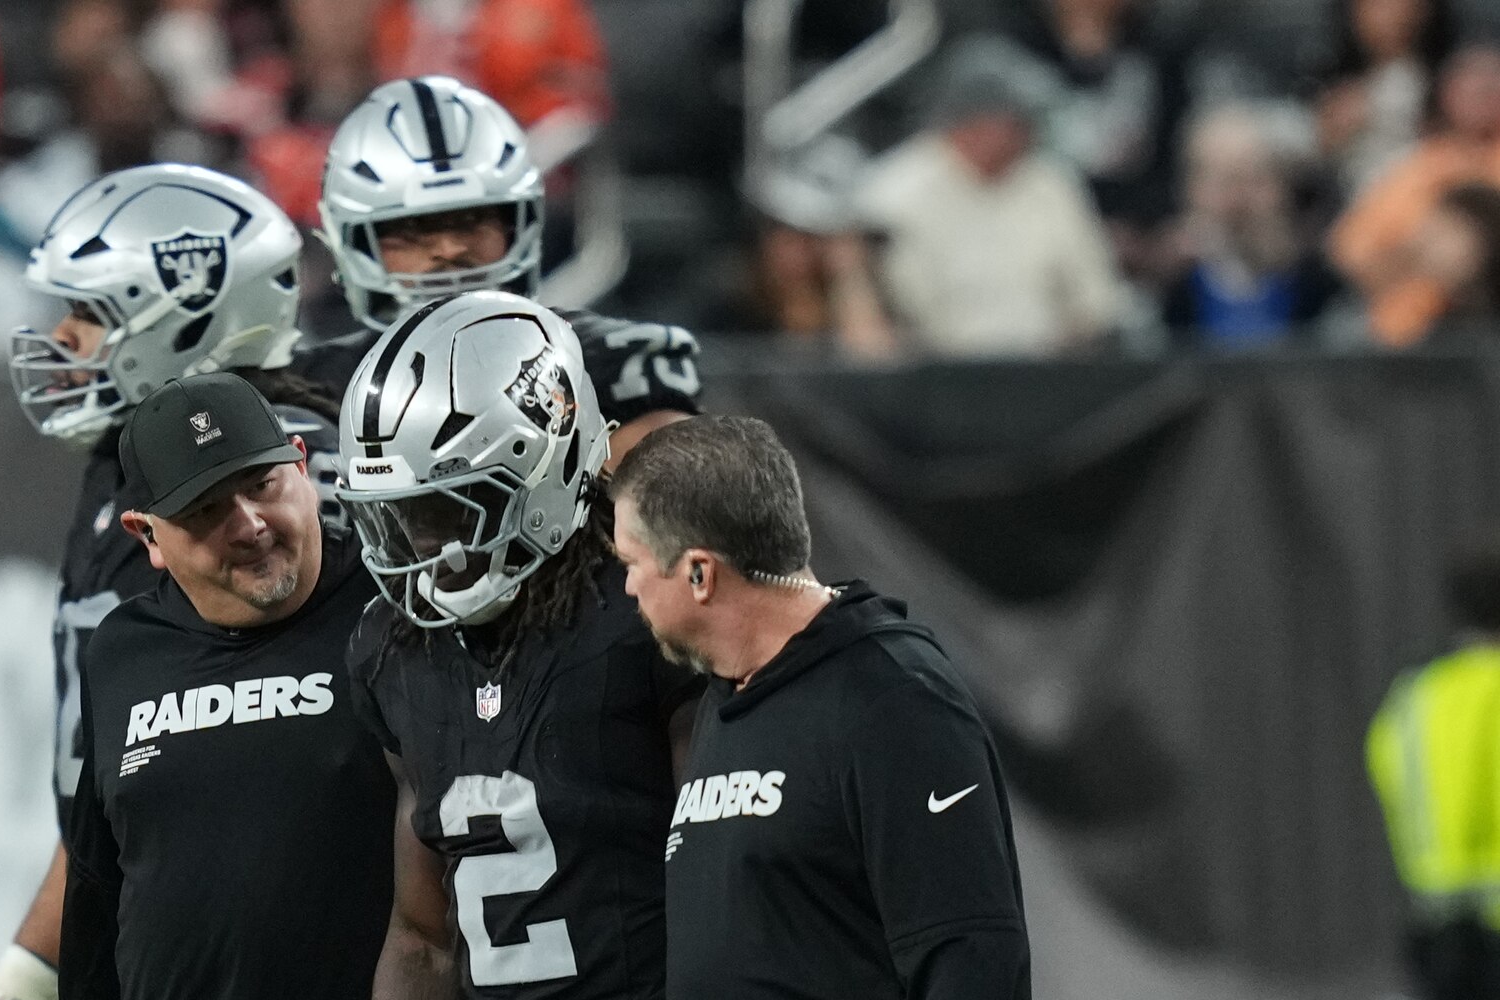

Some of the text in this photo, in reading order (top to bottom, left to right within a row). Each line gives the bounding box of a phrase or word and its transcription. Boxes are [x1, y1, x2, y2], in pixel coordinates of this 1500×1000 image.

[356, 465, 394, 475] RAIDERS
[125, 672, 335, 747] RAIDERS
[480, 699, 497, 714] NFL
[439, 769, 578, 987] 2
